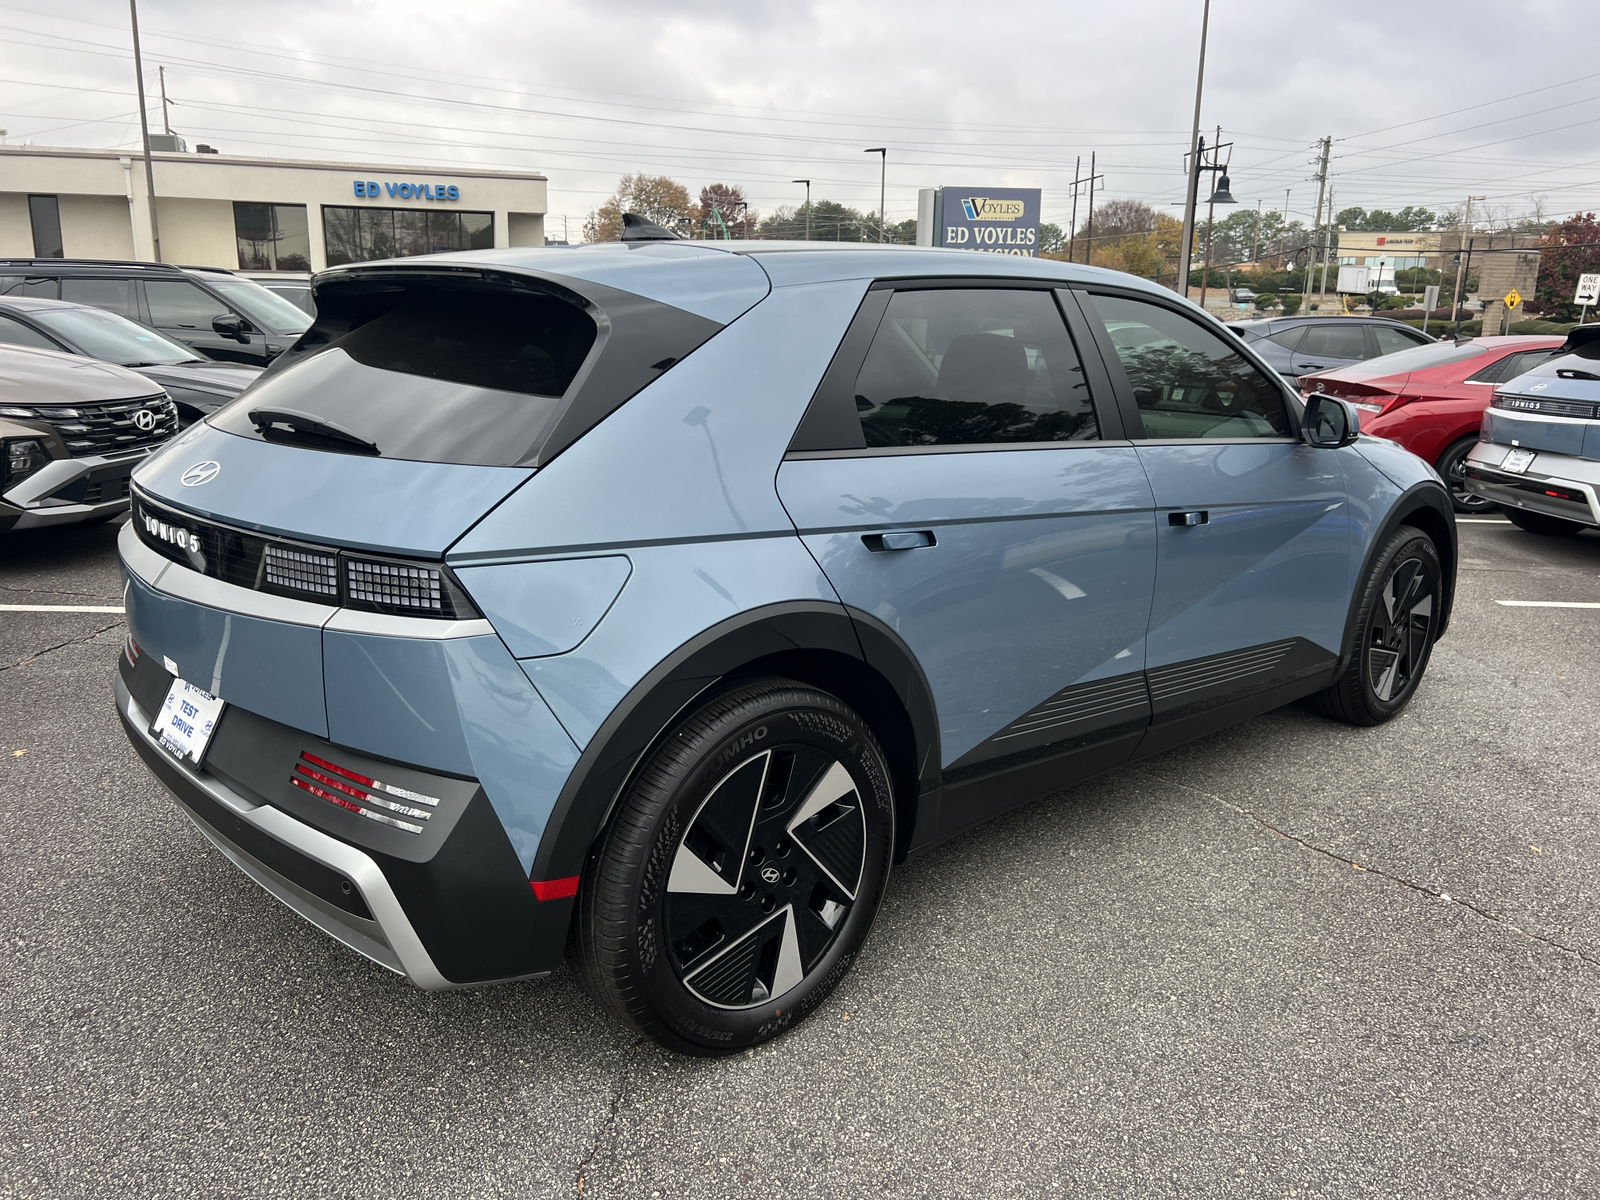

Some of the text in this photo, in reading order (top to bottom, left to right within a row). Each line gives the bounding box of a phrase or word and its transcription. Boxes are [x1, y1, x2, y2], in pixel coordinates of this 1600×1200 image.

[353, 181, 460, 201] ED VOYLES
[970, 198, 1020, 217] VOYLES
[946, 226, 1036, 245] ED VOYLES
[1581, 284, 1598, 292] WAY
[1582, 276, 1599, 284] ONE
[1511, 400, 1534, 409] IONIQ
[145, 516, 201, 553] IONIQ 5
[180, 699, 199, 720] TEST
[171, 714, 194, 738] DRIVE
[159, 736, 167, 746] ED
[165, 741, 184, 760] VOYLES
[696, 1025, 735, 1041] 235/55
